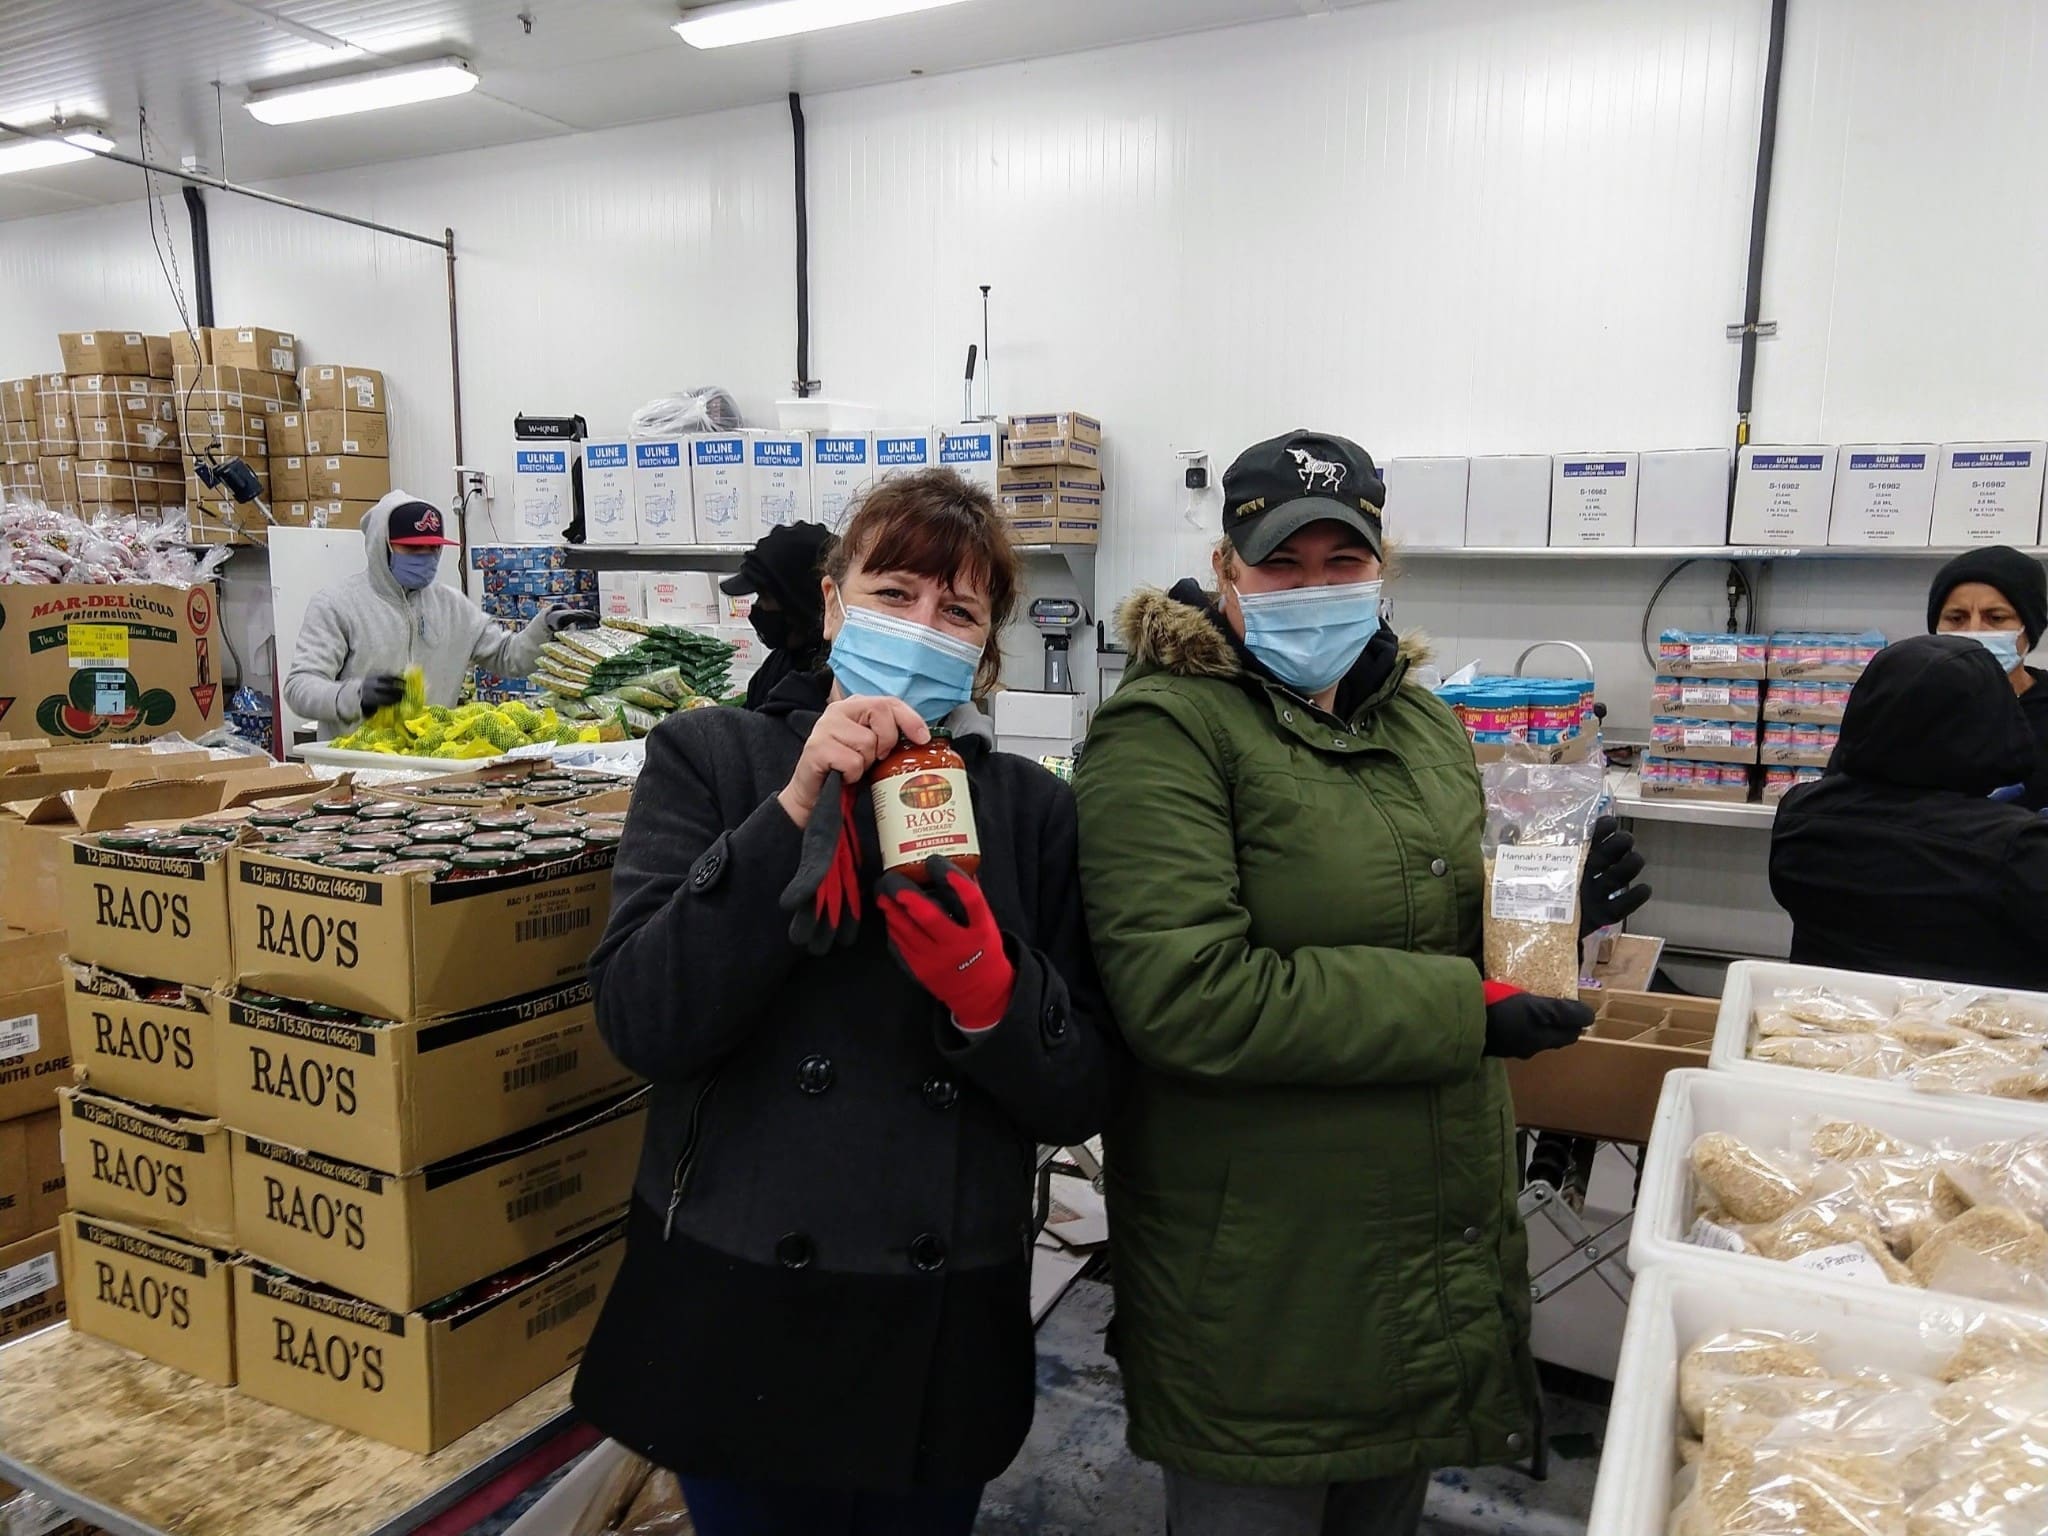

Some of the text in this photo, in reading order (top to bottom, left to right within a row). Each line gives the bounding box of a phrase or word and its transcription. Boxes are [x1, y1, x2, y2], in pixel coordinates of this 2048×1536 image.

[528, 424, 559, 434] W-KING
[705, 442, 733, 454] ULINE
[764, 444, 792, 456] ULINE
[825, 441, 854, 453] ULINE
[887, 441, 916, 453] ULINE
[950, 438, 980, 450] ULINE
[595, 446, 619, 458] ULINE
[644, 445, 670, 456] ULINE
[941, 450, 989, 462] STRETCH WRAP
[527, 453, 555, 464] ULINE
[589, 457, 627, 467] STRETCH WRAP
[639, 456, 678, 467] STRETCH WRAP
[698, 454, 742, 465] STRETCH WRAP
[756, 456, 800, 465] STRETCH WRAP
[818, 453, 864, 463] STRETCH WRAP
[879, 453, 926, 464] STRETCH WRAP
[519, 464, 564, 472] STRETCH WRAP
[31, 592, 174, 619] MAR-DELicious
[63, 609, 142, 621] watermelons
[37, 634, 54, 646] The
[112, 701, 118, 712] 1
[904, 809, 956, 829] RAO'S
[1502, 852, 1574, 864] Hannah's Pantry
[94, 883, 191, 939] RAO'S
[256, 904, 359, 969] RAO'S
[91, 1012, 194, 1070] RAO'S
[35, 1056, 70, 1076] CARE
[250, 1046, 357, 1116] RAO'S
[90, 1138, 188, 1207] RAO'S
[264, 1175, 365, 1251] RAO'S
[95, 1260, 190, 1330] RAO'S
[272, 1316, 384, 1393] RAO'S
